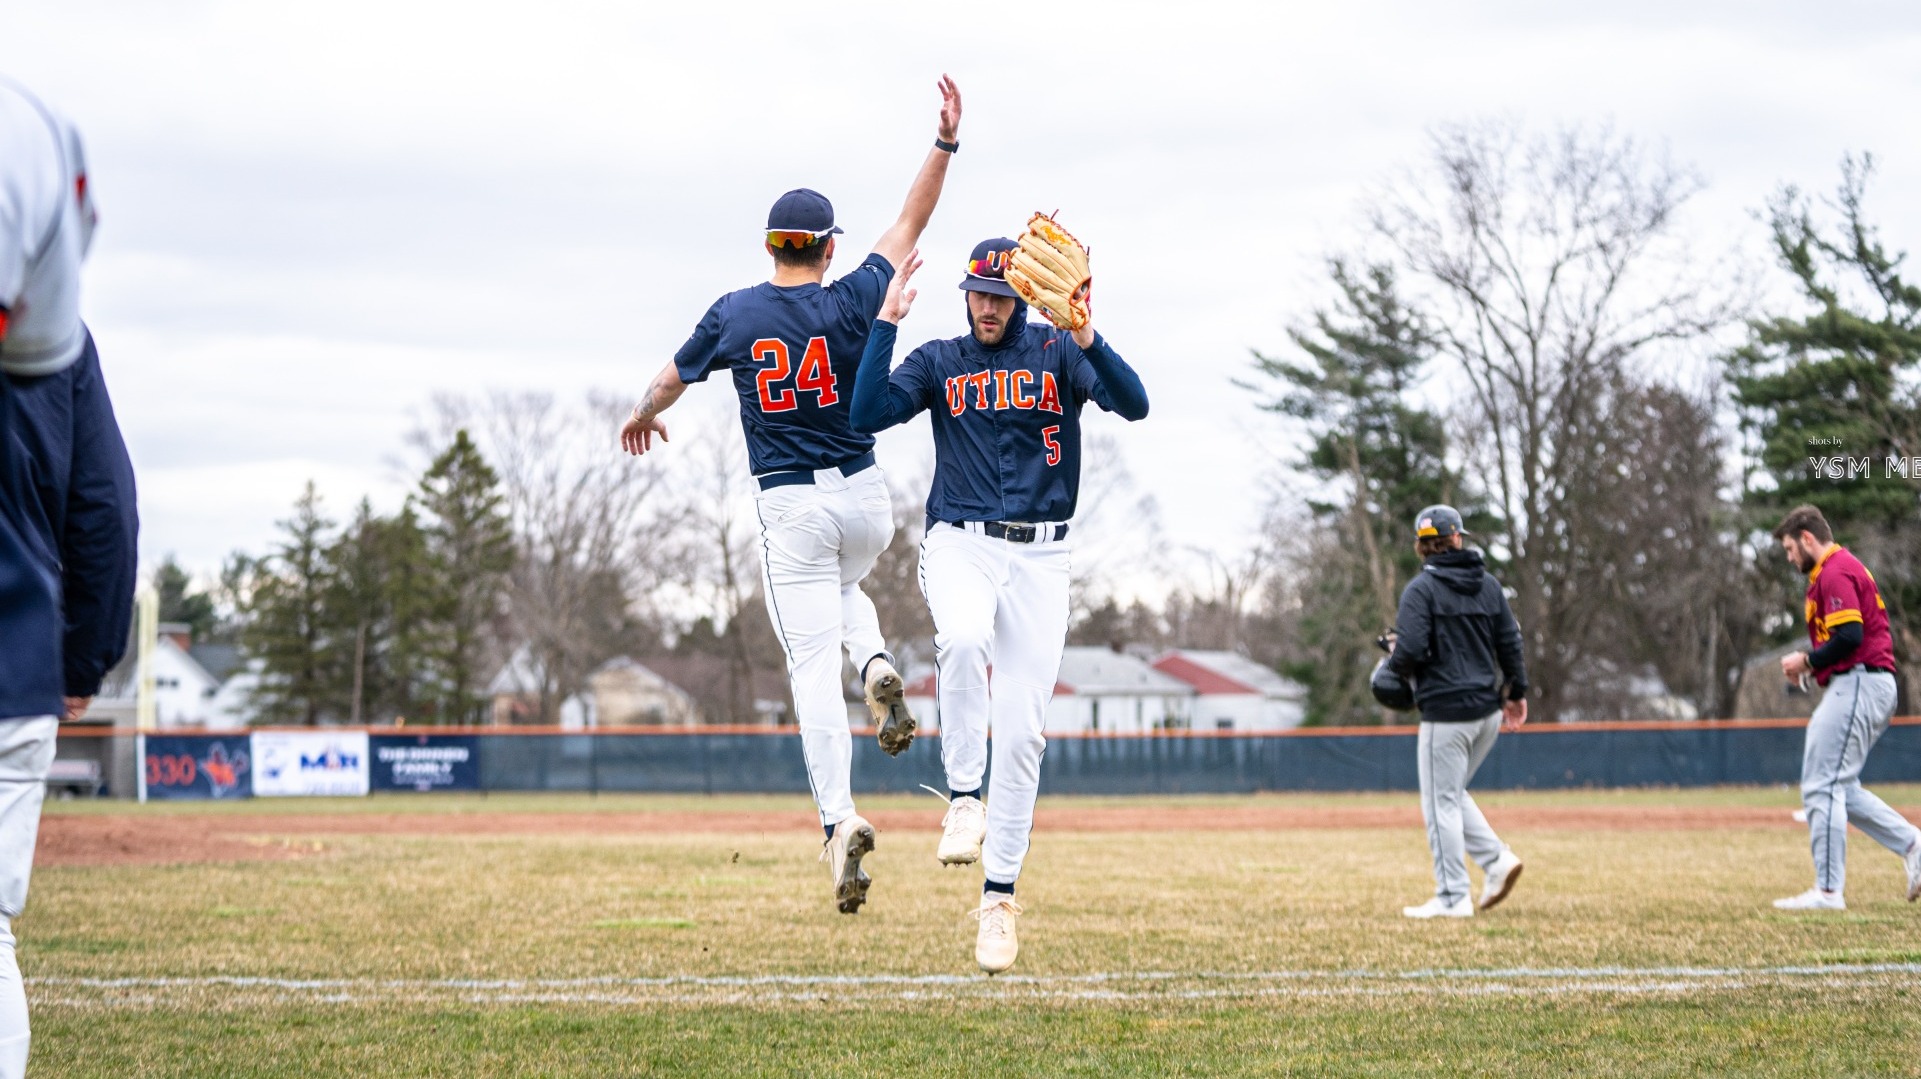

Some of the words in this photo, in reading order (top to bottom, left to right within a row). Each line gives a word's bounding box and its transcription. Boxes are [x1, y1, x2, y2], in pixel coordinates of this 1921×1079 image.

[751, 336, 839, 413] 24
[945, 369, 1063, 417] UTICA
[1042, 425, 1060, 466] 5
[145, 754, 196, 786] 330
